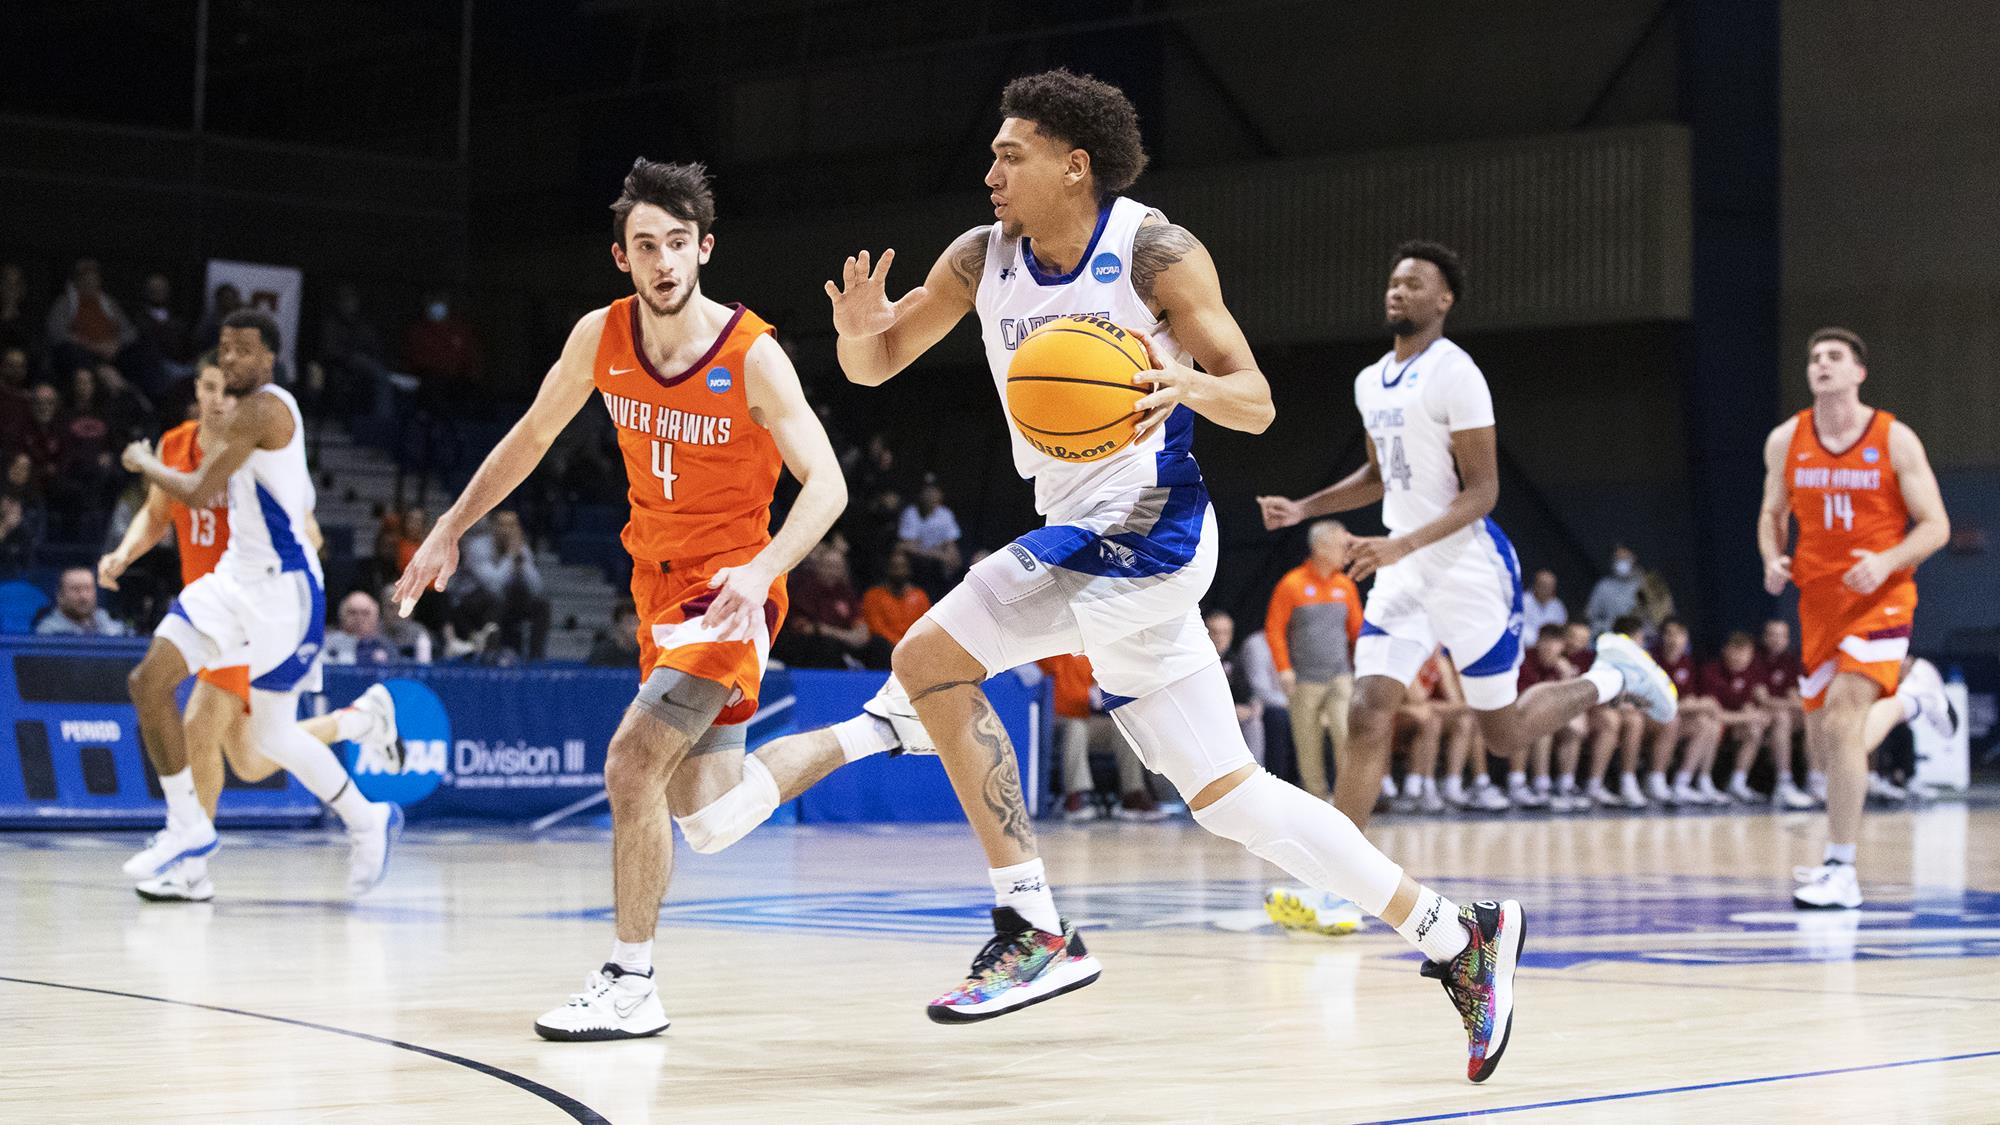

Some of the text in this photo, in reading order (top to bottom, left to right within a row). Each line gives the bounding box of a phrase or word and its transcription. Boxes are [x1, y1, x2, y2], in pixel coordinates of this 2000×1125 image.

[1095, 265, 1121, 275] NCAA
[709, 378, 732, 387] NCAA
[655, 406, 732, 446] HAWKS
[650, 440, 680, 501] 4
[190, 507, 216, 547] 13
[1823, 492, 1856, 531] 14
[60, 719, 122, 742] PERIOD
[455, 738, 585, 775] Division III
